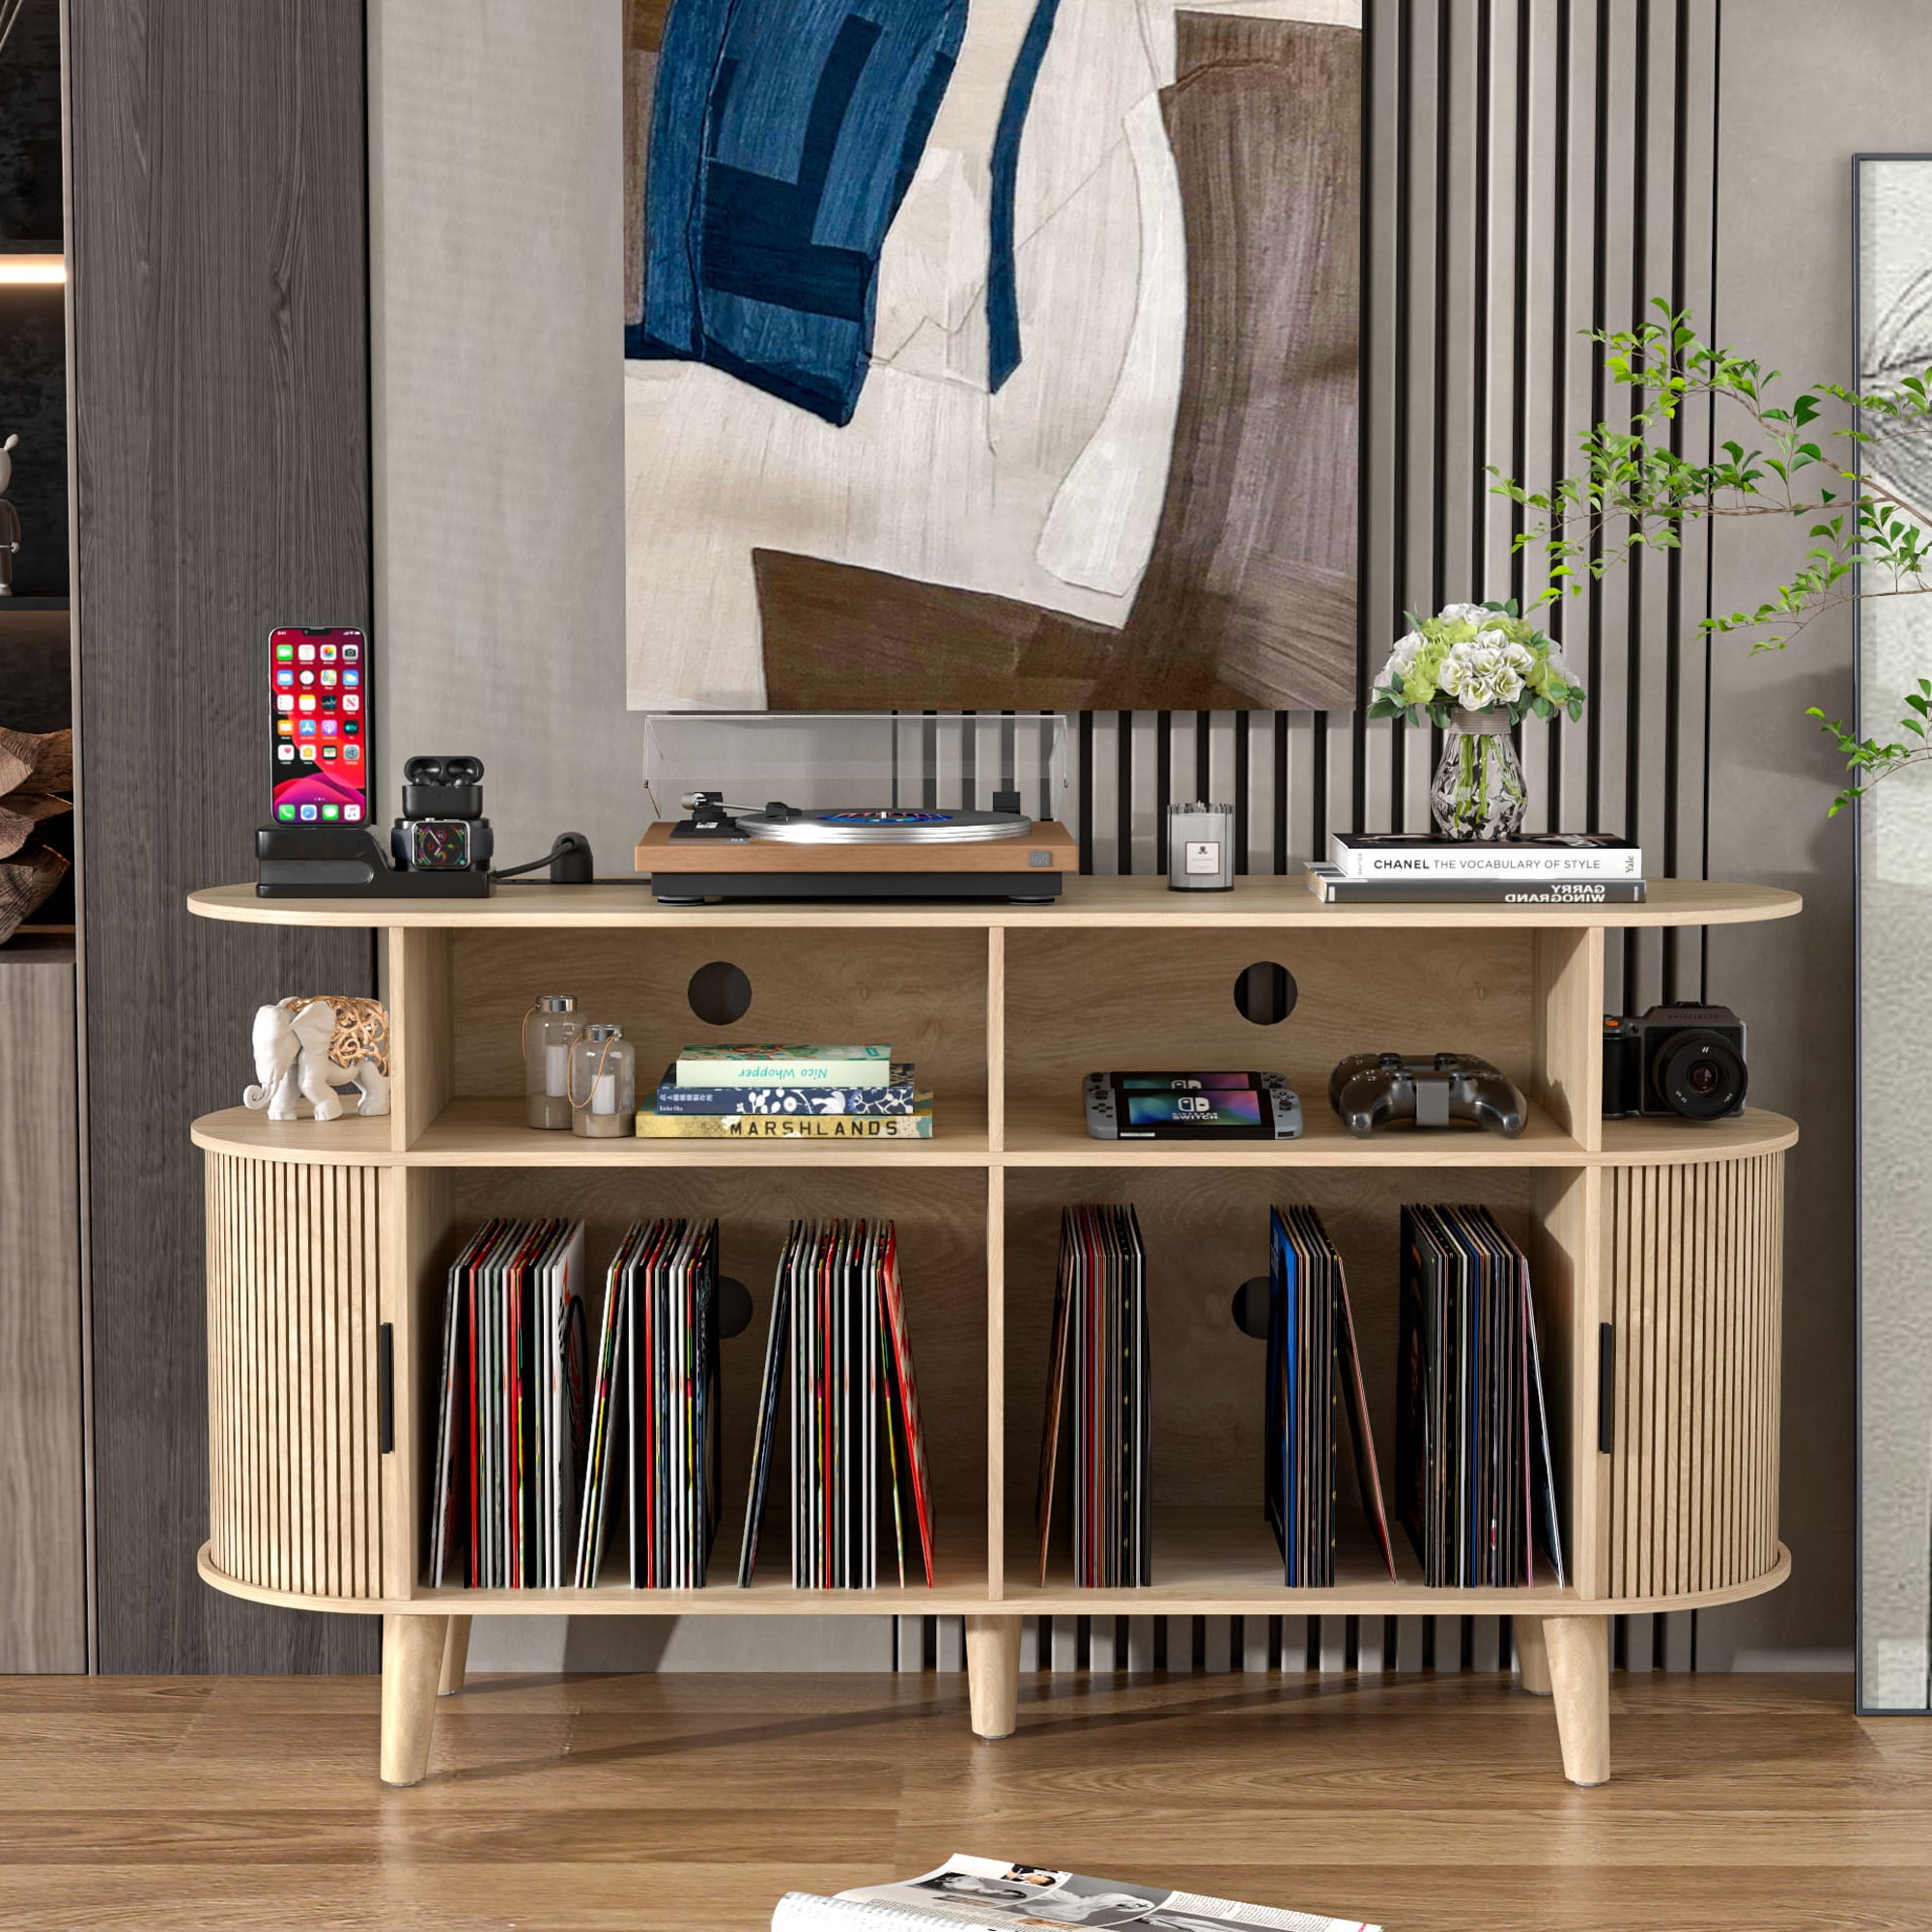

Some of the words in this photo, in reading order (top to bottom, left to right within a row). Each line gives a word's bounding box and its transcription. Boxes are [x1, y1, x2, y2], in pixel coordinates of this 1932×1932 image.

[1374, 859, 1429, 869] CHANEL
[1434, 859, 1456, 869] THE
[1460, 859, 1541, 869] VOCABULARY
[1545, 859, 1561, 869] OF
[1564, 859, 1601, 869] STYLE
[1625, 855, 1634, 873] Yale
[738, 1062, 796, 1080] Whopper
[800, 1067, 828, 1080] Nico
[730, 1121, 897, 1136] MARSHLANDS
